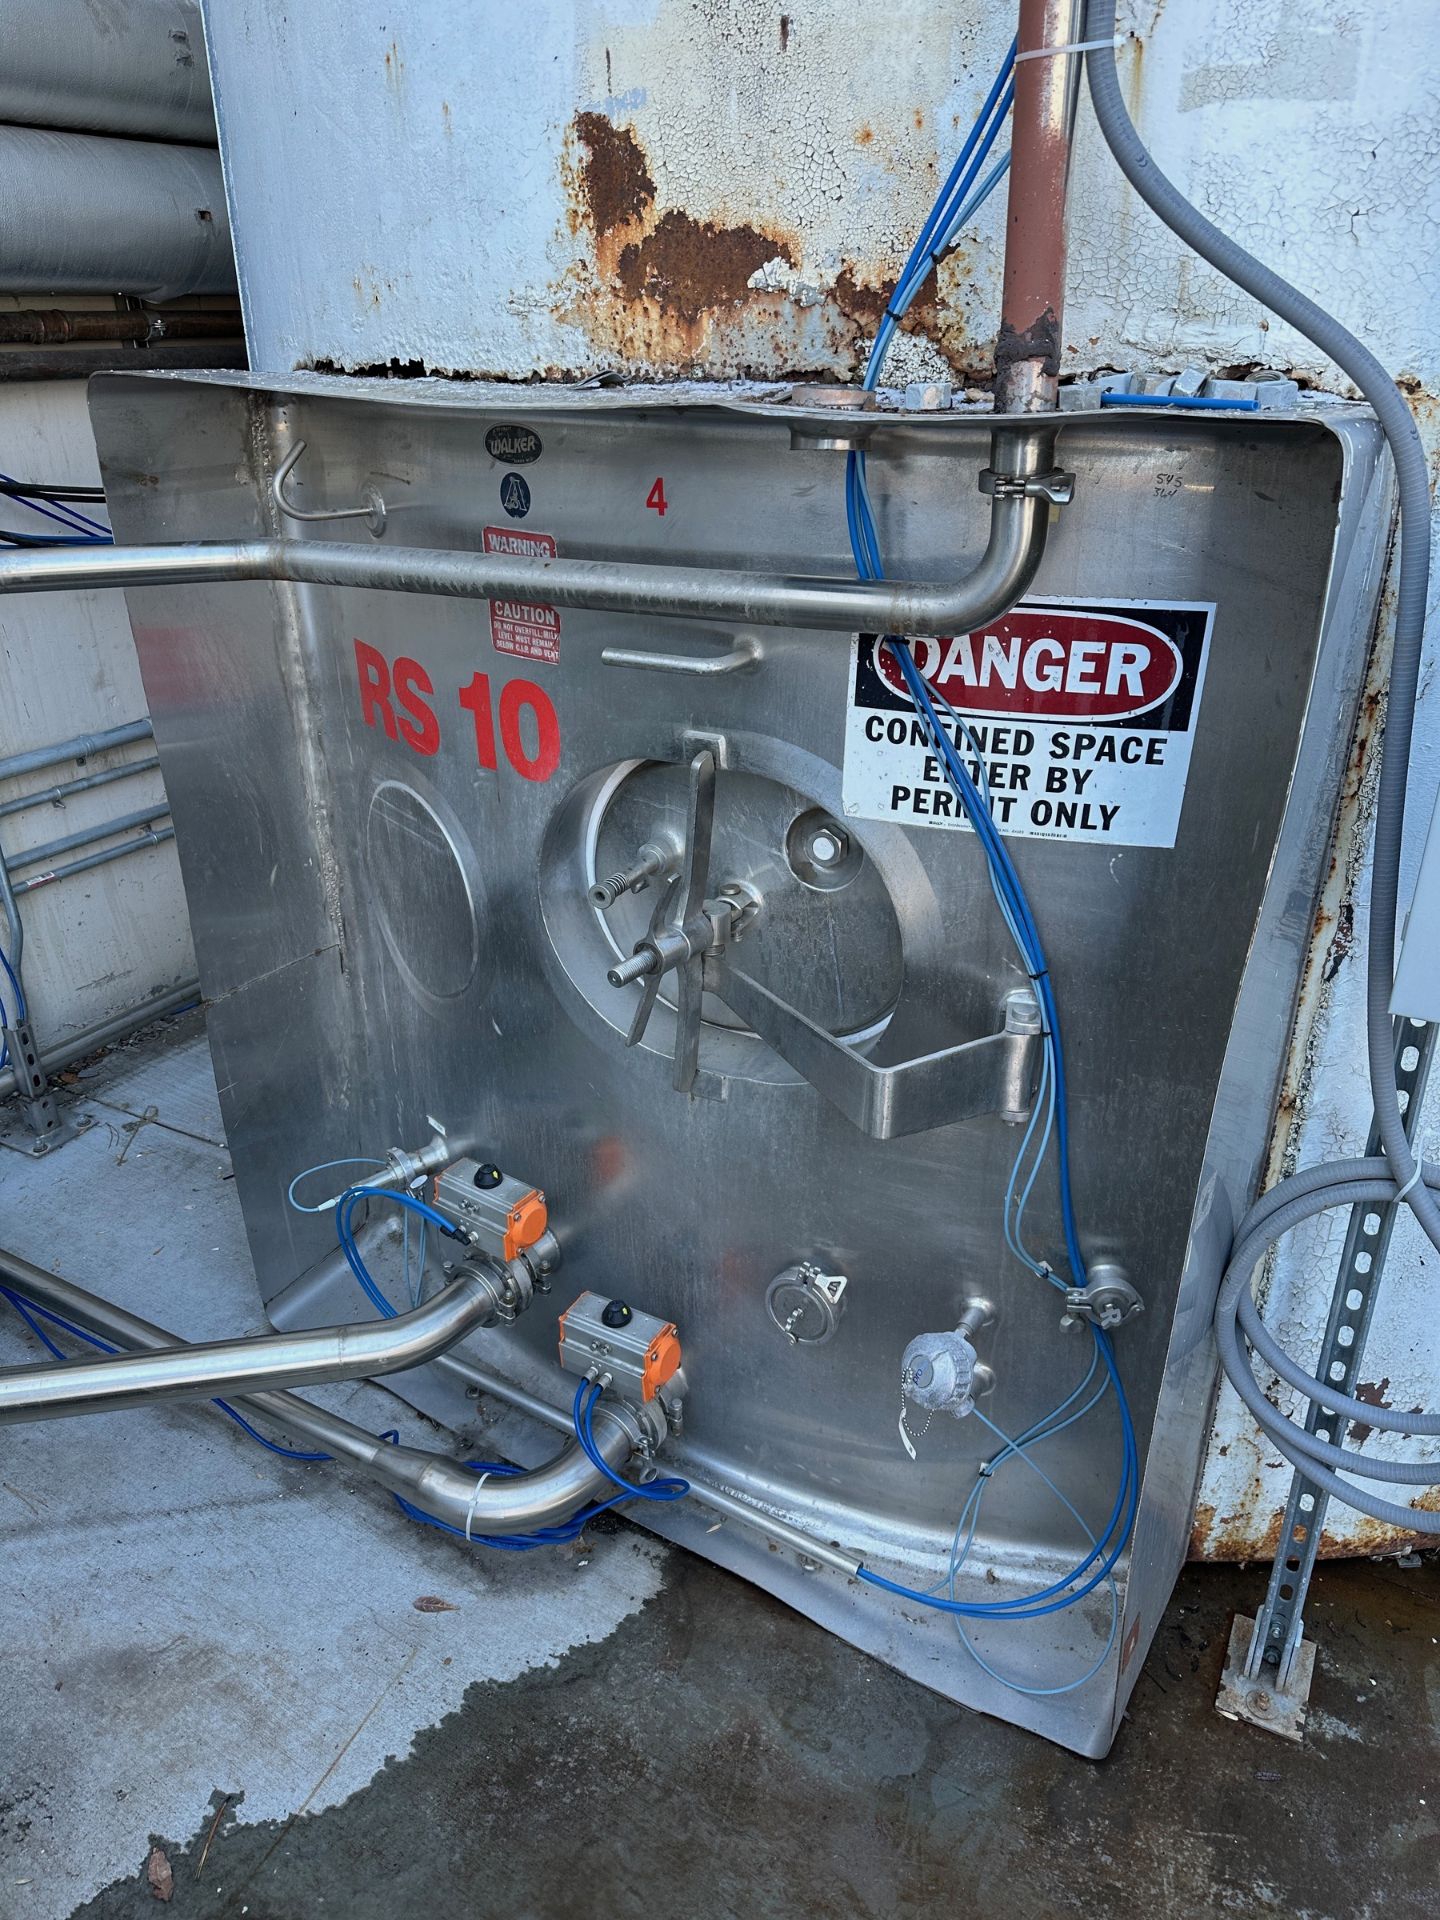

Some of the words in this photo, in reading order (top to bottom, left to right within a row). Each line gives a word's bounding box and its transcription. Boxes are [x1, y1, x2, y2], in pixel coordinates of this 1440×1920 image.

[490, 435, 536, 455] WALKER
[645, 477, 668, 516] 4
[487, 533, 551, 558] WARNING
[494, 600, 555, 626] CAUTION
[900, 634, 1151, 697] DANGER
[353, 638, 441, 757] RS
[458, 671, 561, 783] 10
[1048, 732, 1168, 766] SPACE
[923, 755, 1031, 791] ETER
[1045, 766, 1093, 795] BY
[1030, 799, 1121, 831] ONLY
